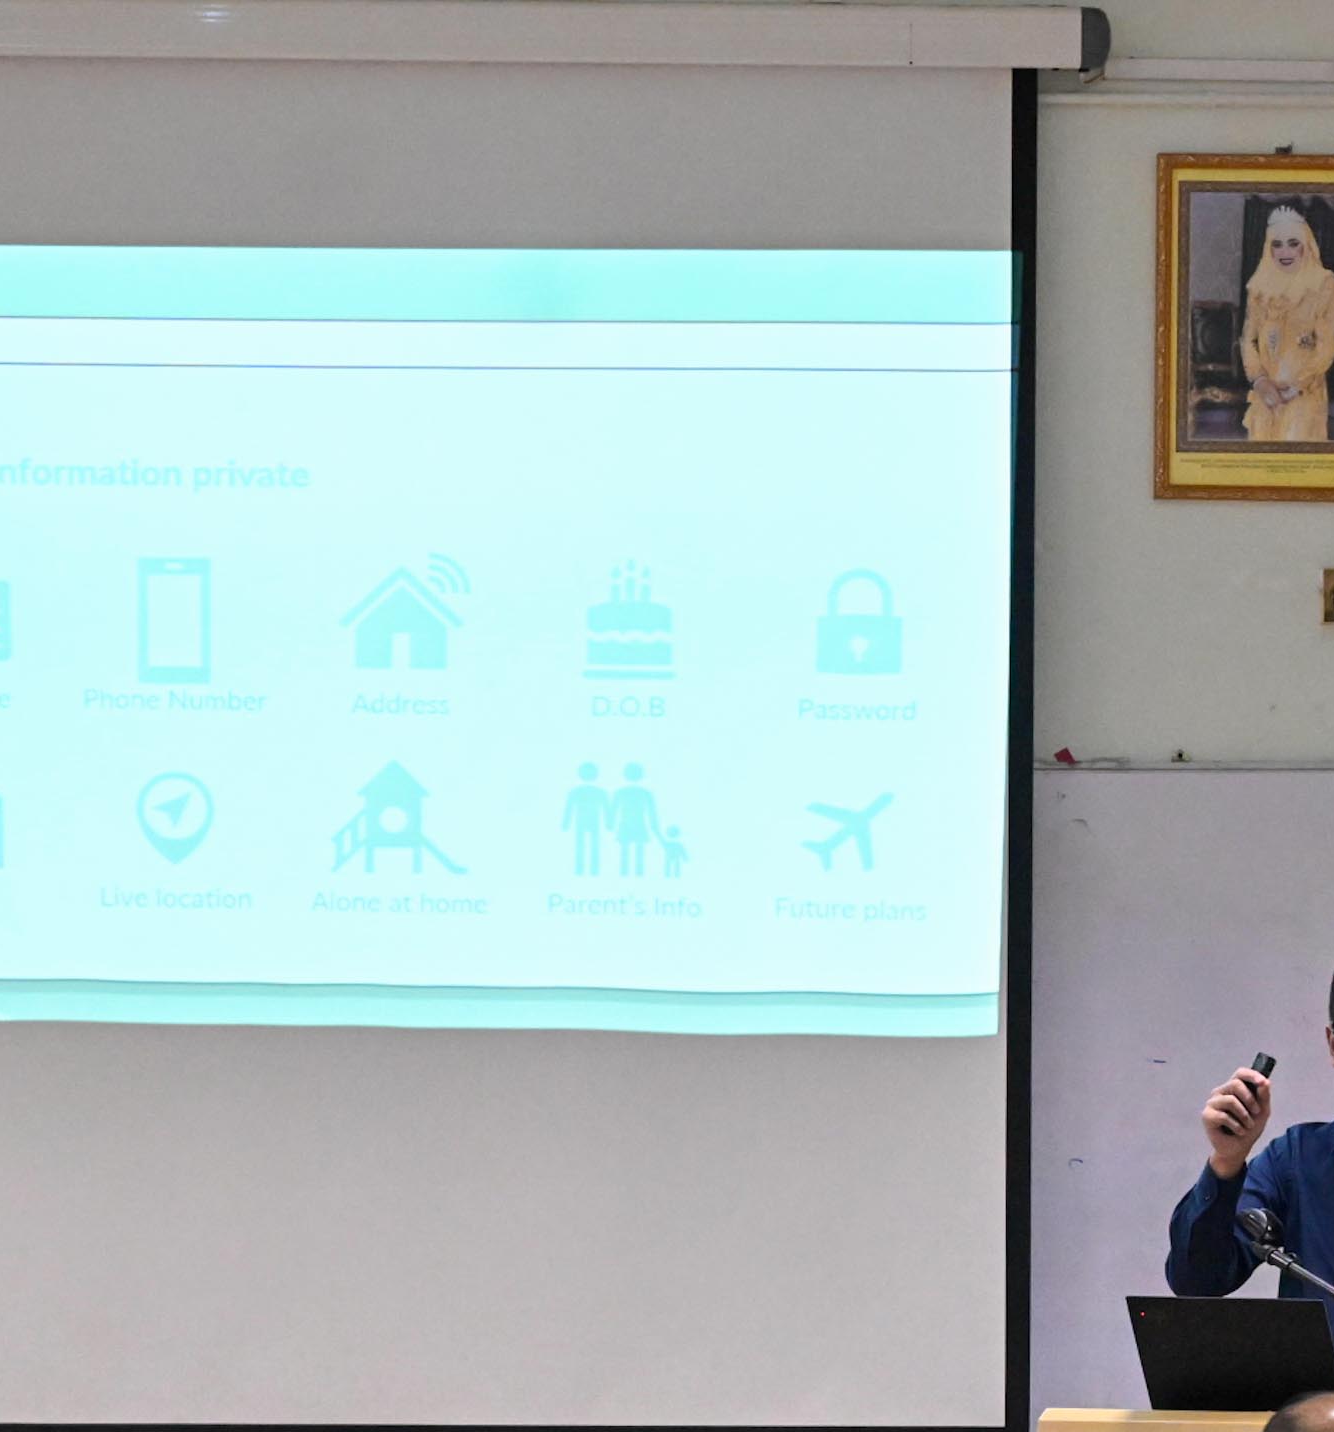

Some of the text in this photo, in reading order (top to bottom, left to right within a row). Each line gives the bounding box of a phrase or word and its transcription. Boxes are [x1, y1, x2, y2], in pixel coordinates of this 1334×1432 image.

[191, 458, 315, 496] private
[81, 685, 268, 714] Phone Number
[349, 692, 451, 720] Address
[590, 694, 667, 719] D.O.B
[795, 696, 920, 721] Password
[98, 884, 255, 911] Live location
[311, 890, 491, 915] Alone at home
[545, 891, 704, 919] Parent's Info
[774, 896, 928, 923] Future plans
